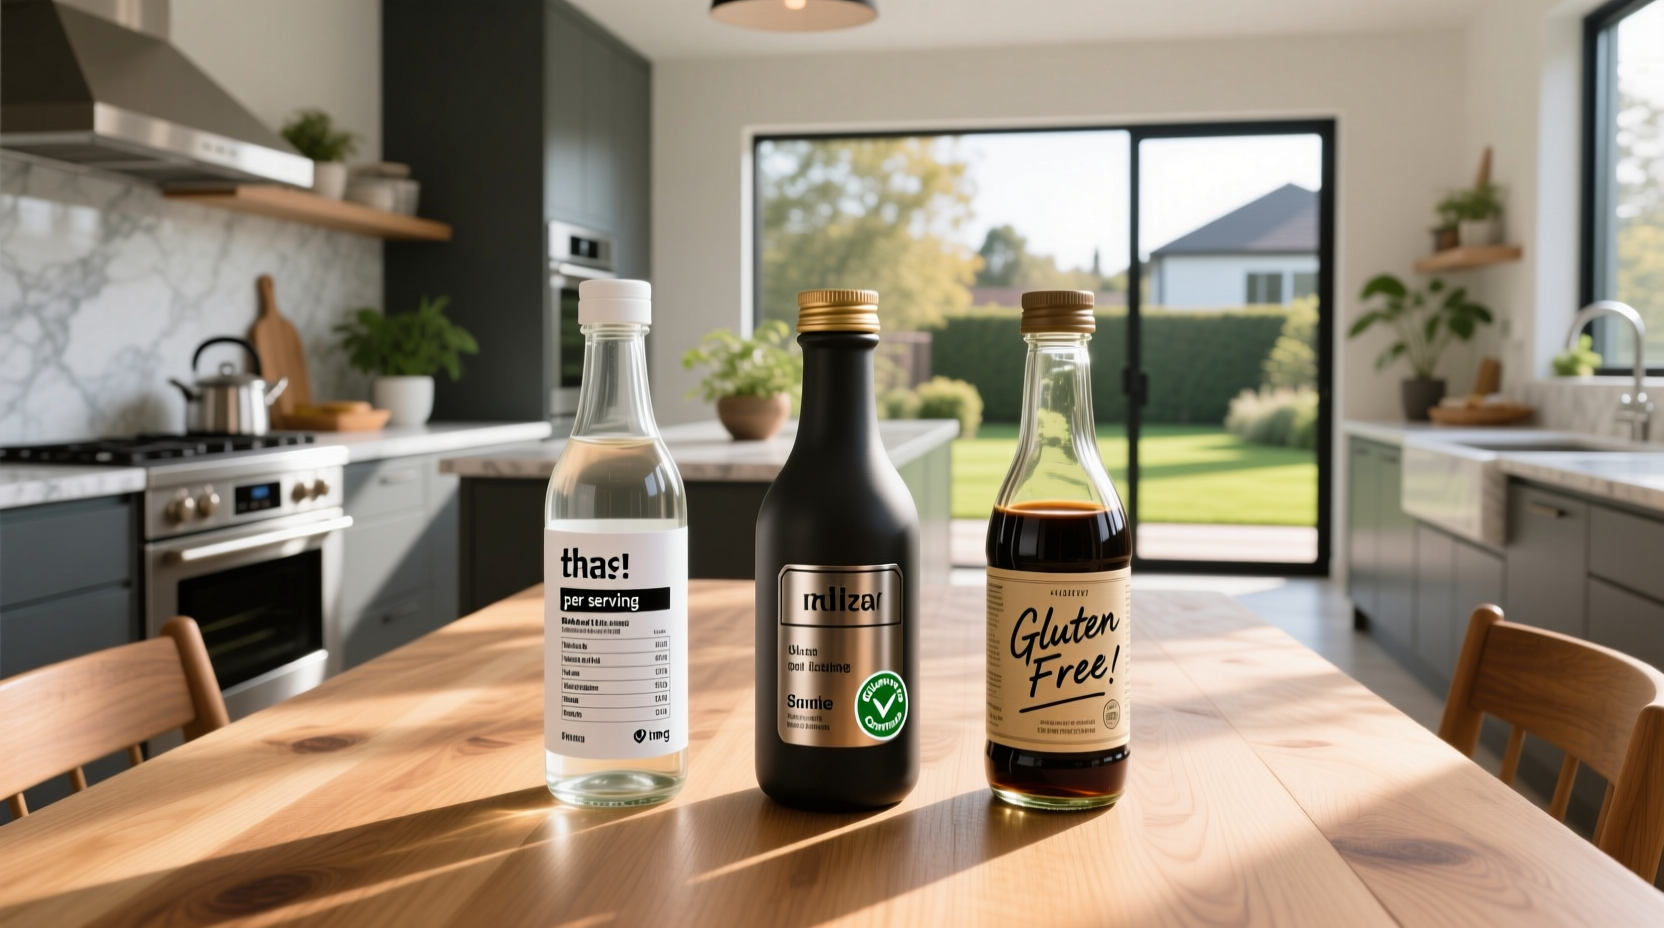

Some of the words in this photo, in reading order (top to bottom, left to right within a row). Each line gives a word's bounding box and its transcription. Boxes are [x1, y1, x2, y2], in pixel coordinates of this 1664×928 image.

[564, 595, 585, 611] per
[588, 592, 640, 611] serving
[1010, 606, 1120, 667] Gluten
[1029, 644, 1120, 698] Free!
